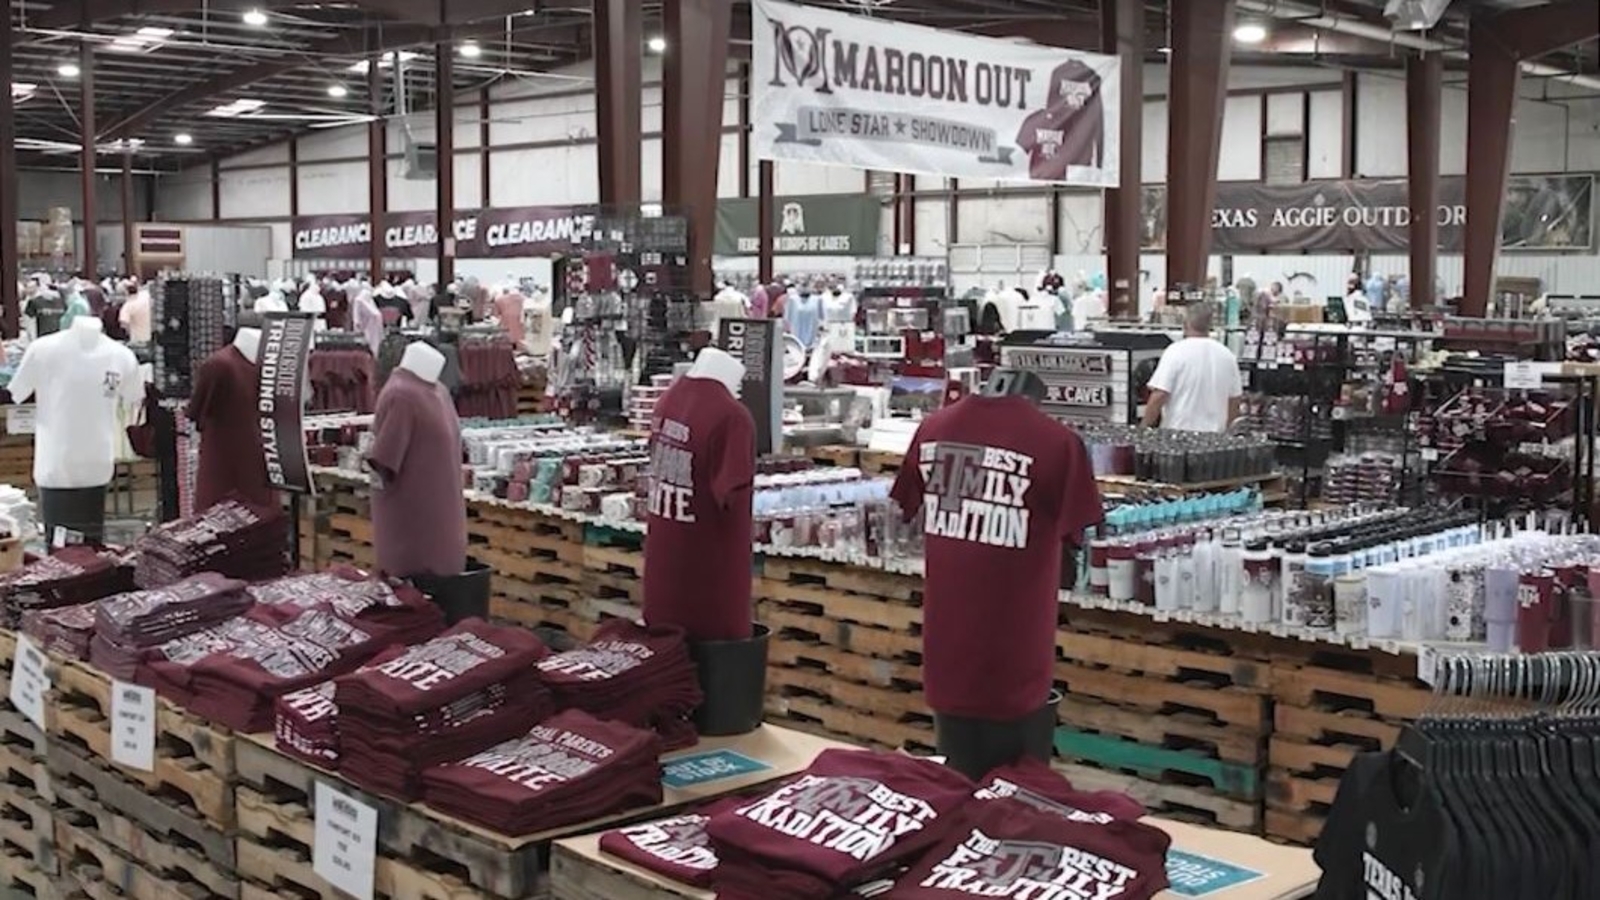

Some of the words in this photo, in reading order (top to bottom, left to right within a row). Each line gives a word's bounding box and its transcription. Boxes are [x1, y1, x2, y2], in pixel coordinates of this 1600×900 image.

[833, 40, 968, 103] MAROON
[975, 62, 1032, 110] OUT
[809, 111, 846, 135] LONE
[850, 114, 889, 137] STAR
[911, 119, 992, 151] SHOWDOWN
[487, 215, 596, 247] CLEARANCE
[1211, 207, 1258, 228] EXAS
[1271, 206, 1335, 228] AGGIE
[728, 322, 746, 357] DRI
[259, 319, 286, 412] TRENDING
[260, 417, 285, 485] STYLES
[981, 446, 1034, 476] BEST
[556, 730, 614, 759] PARENTS
[867, 783, 938, 821] BEST
[735, 798, 896, 864] TRADITION
[964, 828, 1001, 855] THE
[1166, 857, 1227, 878] STOC
